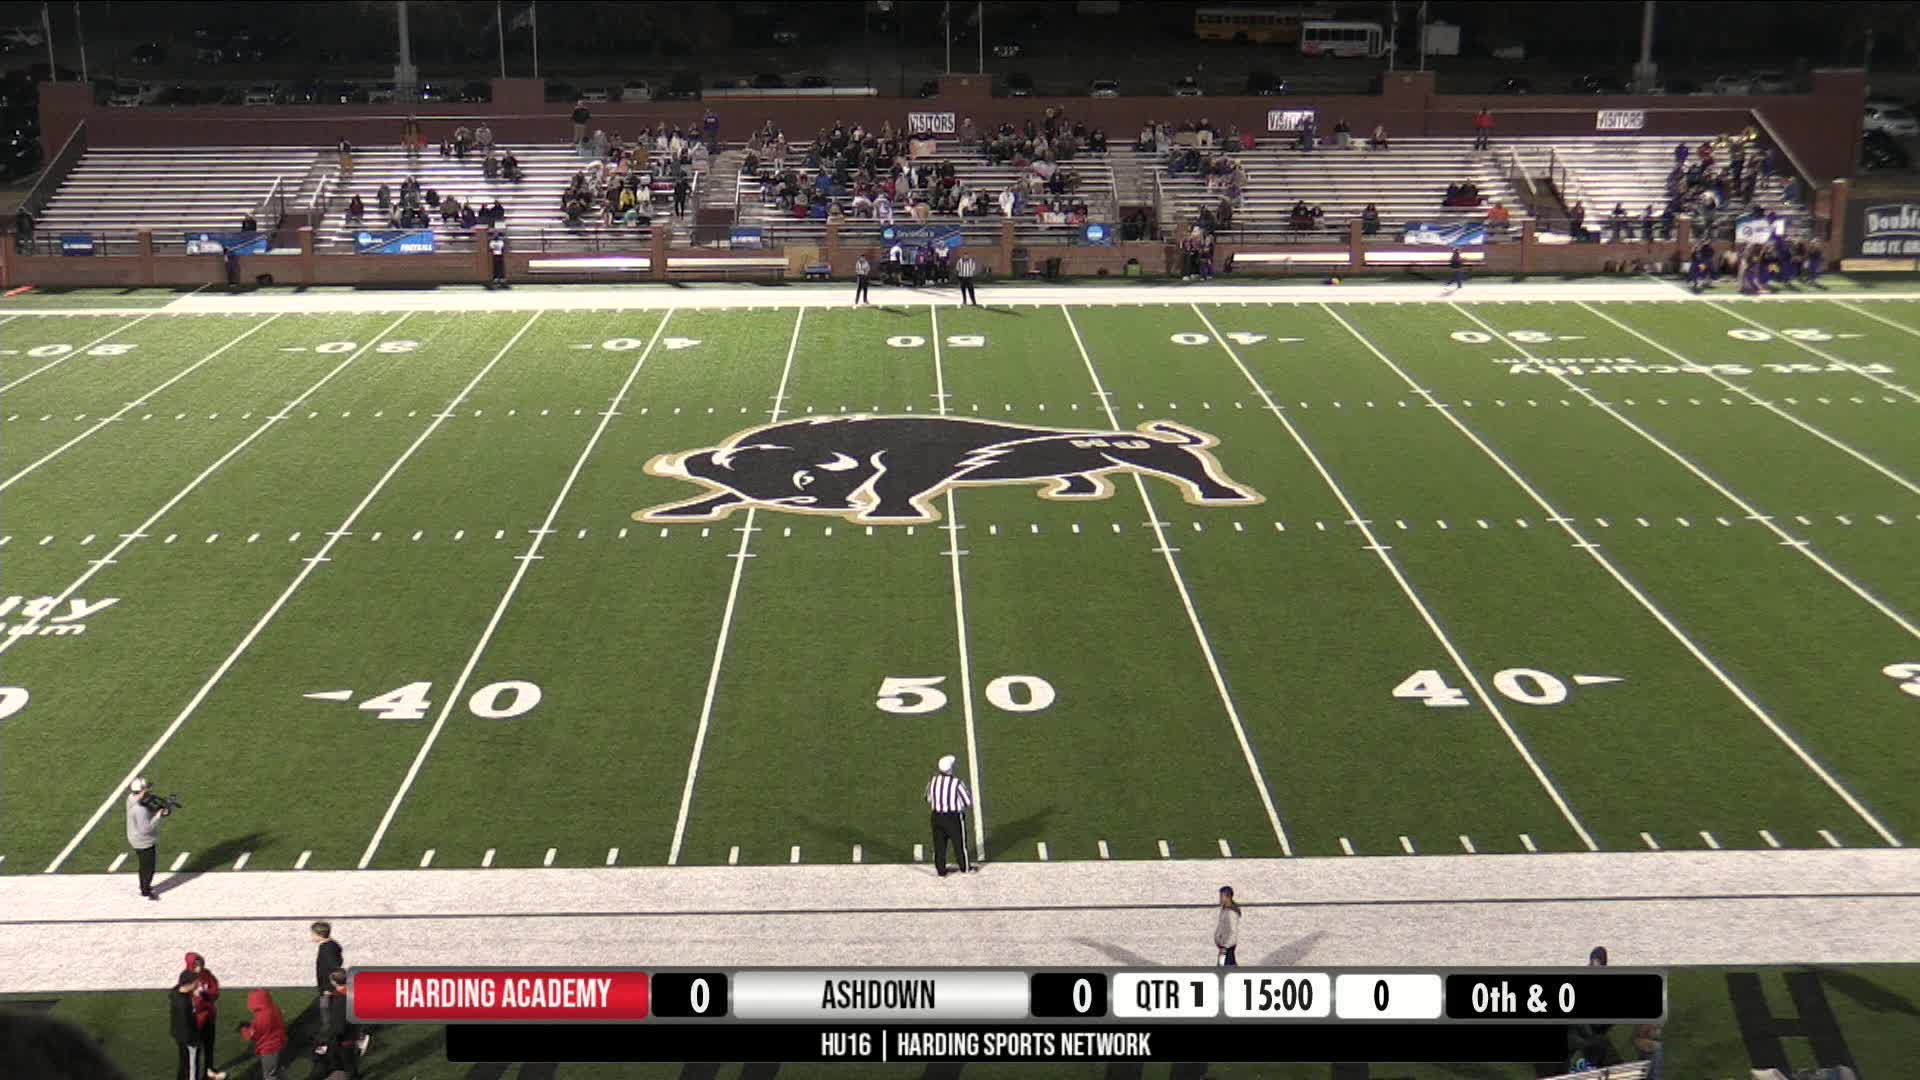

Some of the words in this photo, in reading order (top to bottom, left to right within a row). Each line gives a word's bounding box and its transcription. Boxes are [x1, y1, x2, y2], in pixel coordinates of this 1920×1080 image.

[909, 113, 954, 132] VISITORS
[1598, 111, 1643, 128] VISITORS
[886, 335, 985, 348] 50
[359, 680, 542, 720] 40
[876, 675, 1056, 714] 50
[1391, 668, 1568, 707] 40
